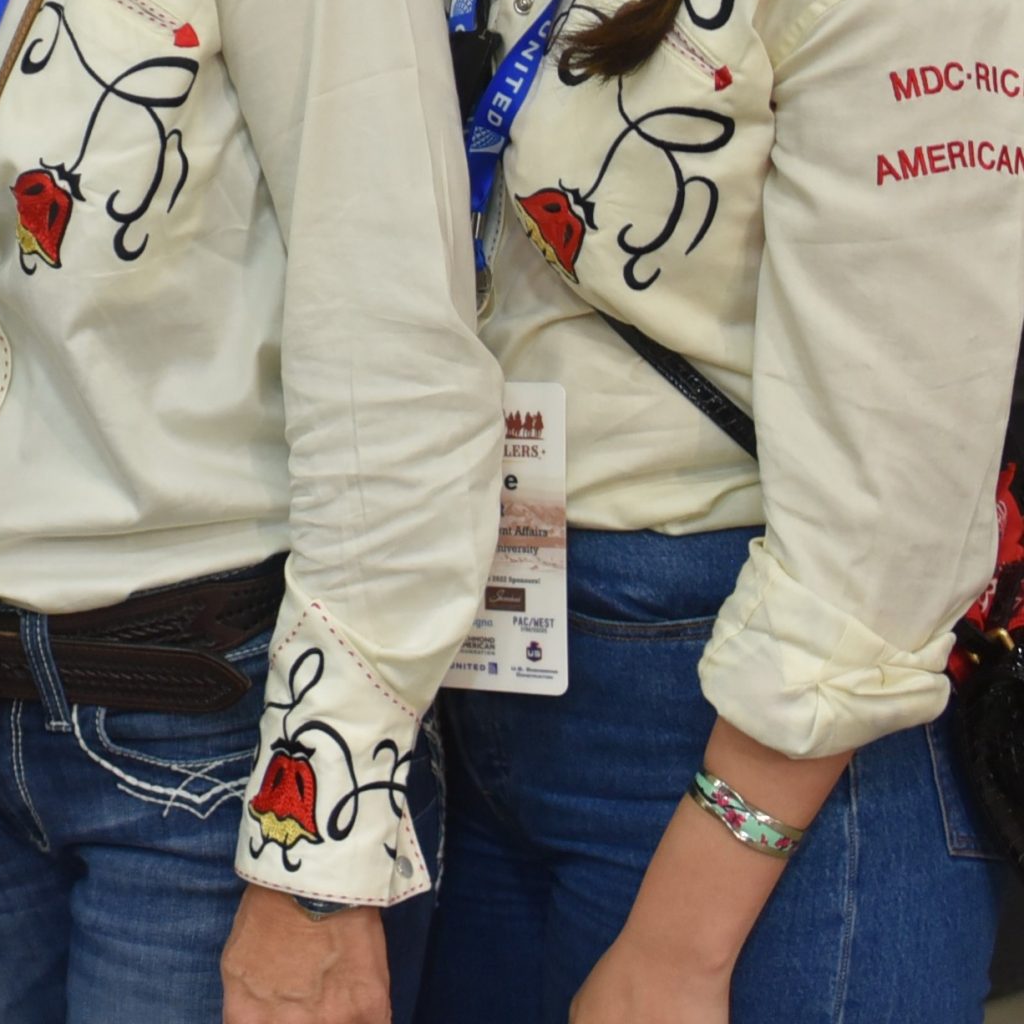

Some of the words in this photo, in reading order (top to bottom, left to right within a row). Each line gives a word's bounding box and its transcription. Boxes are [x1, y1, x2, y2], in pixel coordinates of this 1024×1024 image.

[487, 20, 552, 127] UNITED
[889, 61, 1024, 102] MDC·RIC
[515, 525, 548, 537] Affairs
[496, 544, 538, 556] niversity
